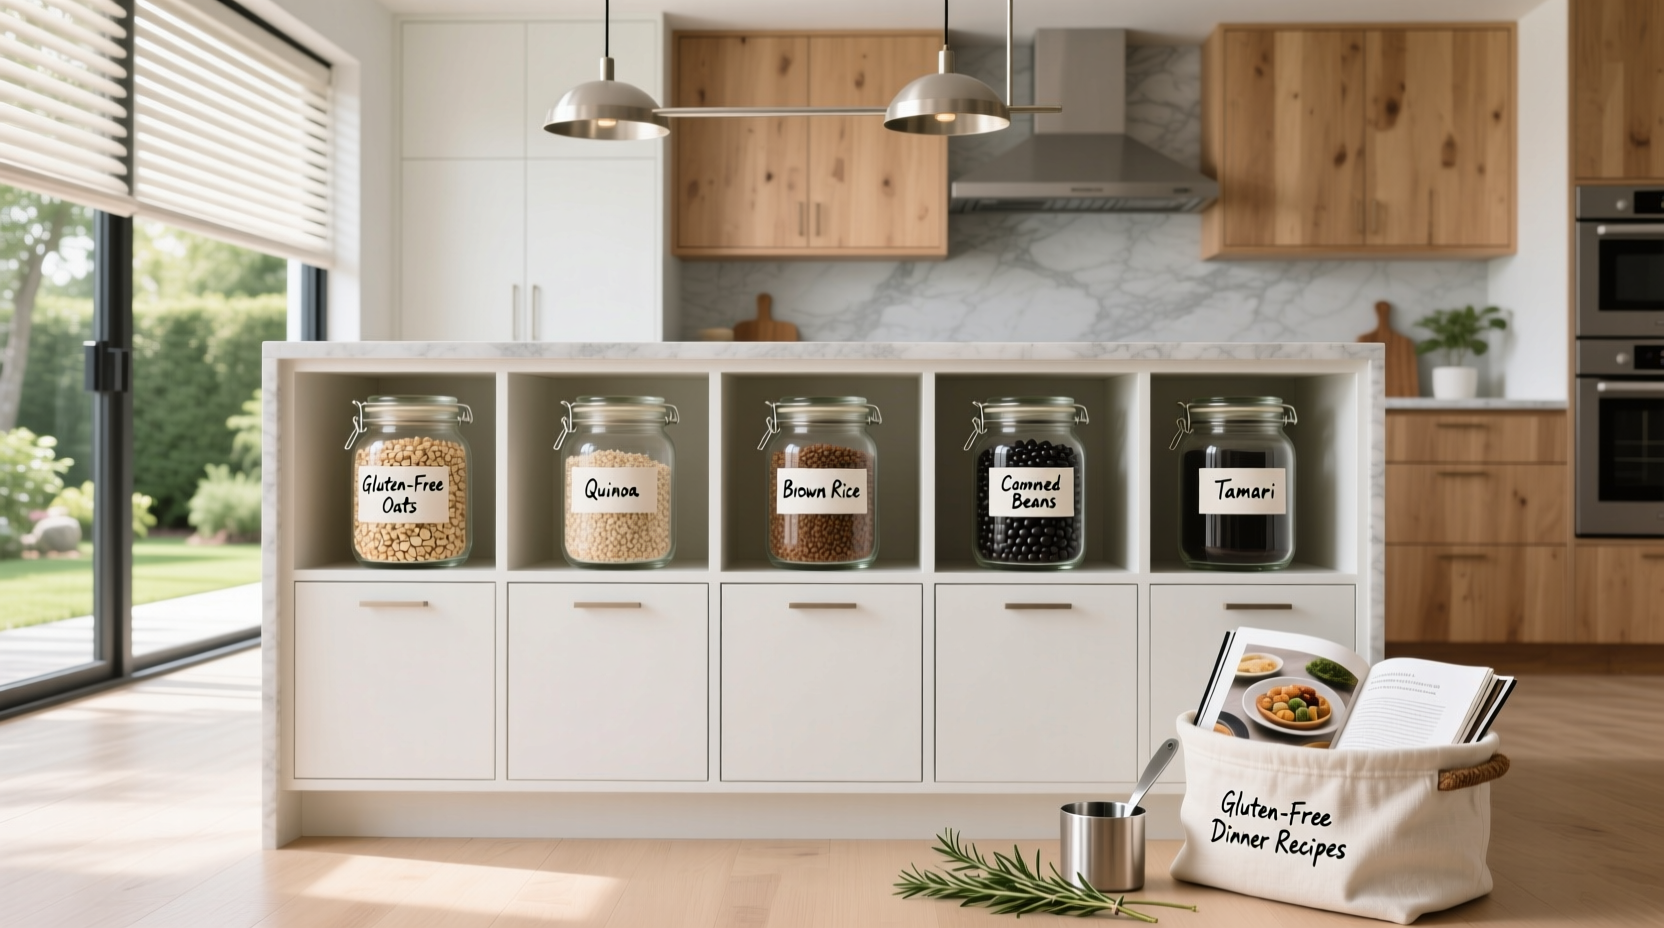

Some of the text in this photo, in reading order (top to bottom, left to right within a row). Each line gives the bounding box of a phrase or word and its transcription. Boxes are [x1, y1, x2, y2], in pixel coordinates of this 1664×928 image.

[362, 474, 444, 495] Gluten-Free
[584, 477, 640, 501] Quinoa
[830, 478, 861, 499] Rice
[1214, 478, 1275, 501] Tamari
[382, 496, 417, 514] Oats
[1011, 492, 1057, 510] Beans
[1221, 789, 1332, 827] Gluten-Free
[1210, 818, 1347, 868] Dinner Recipes
